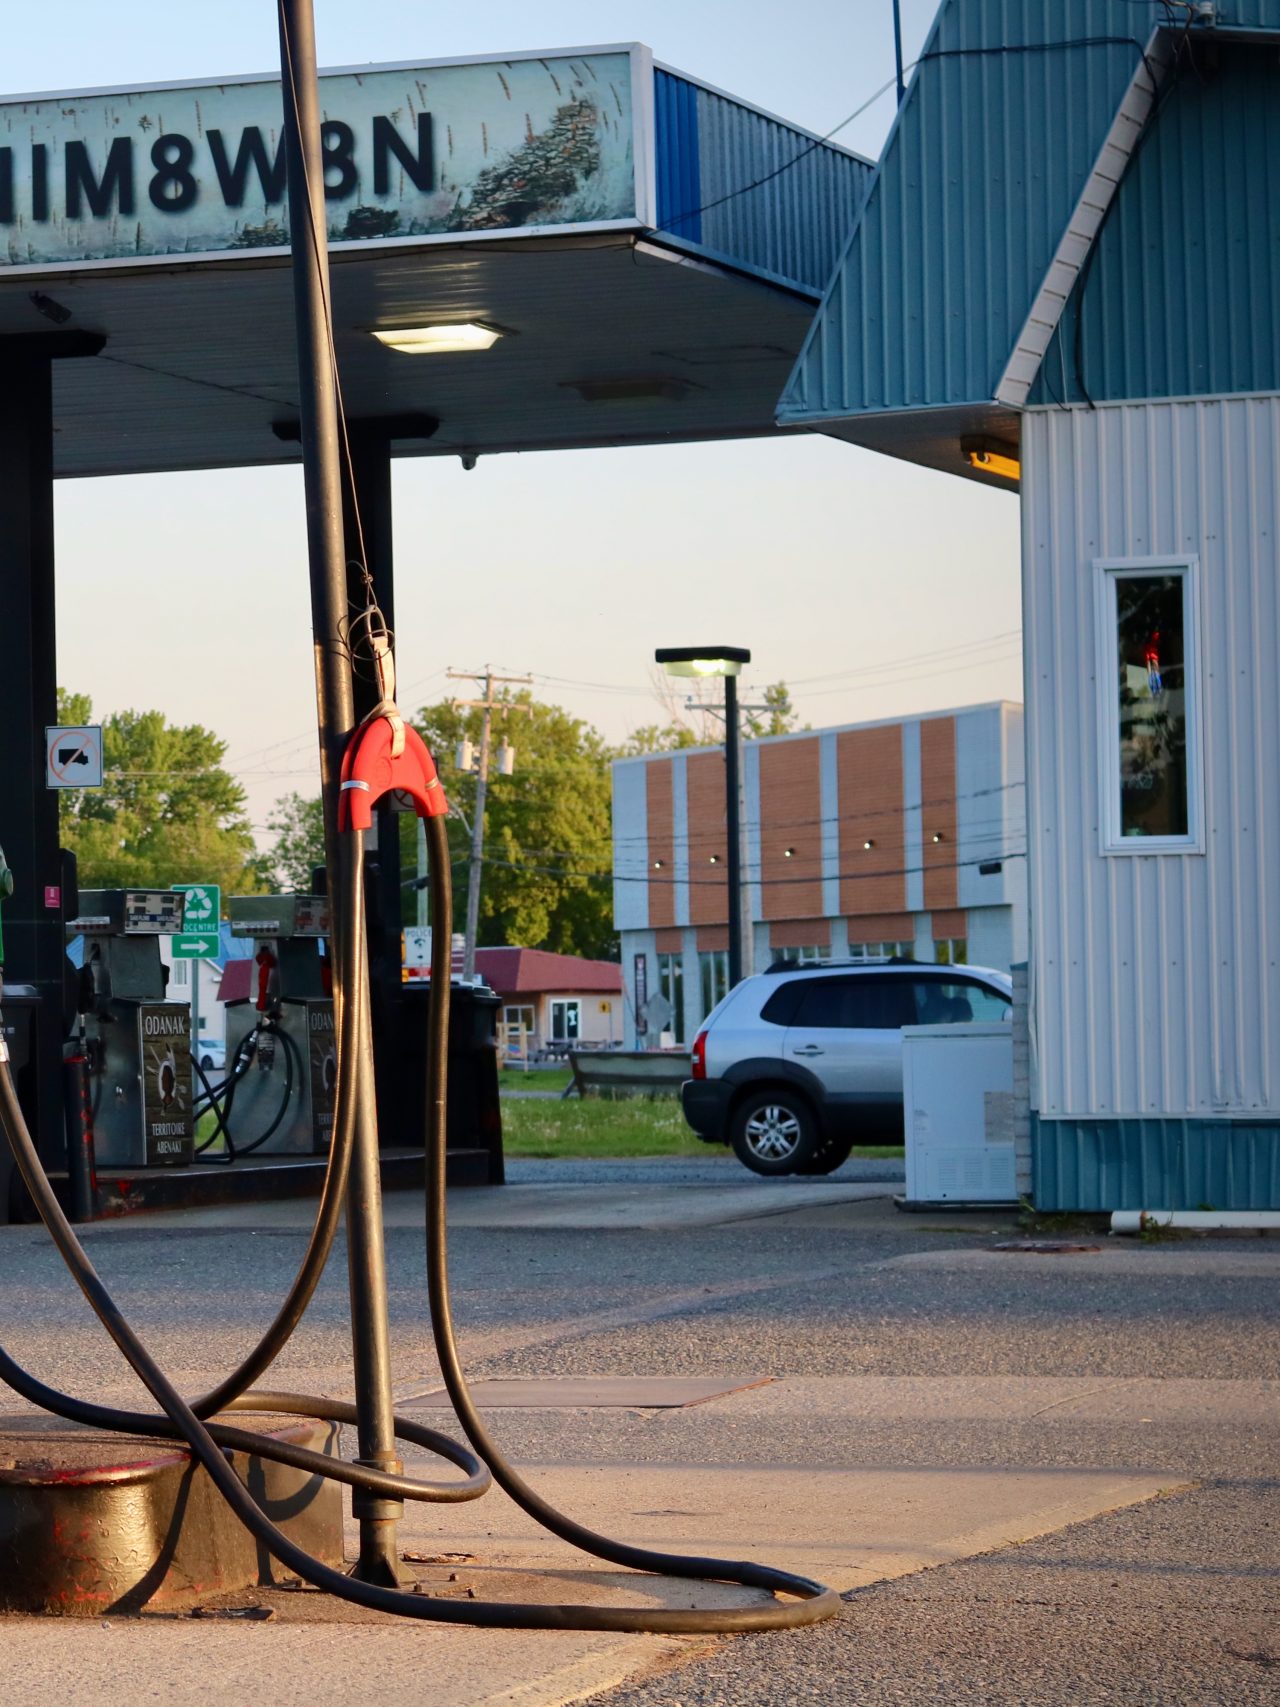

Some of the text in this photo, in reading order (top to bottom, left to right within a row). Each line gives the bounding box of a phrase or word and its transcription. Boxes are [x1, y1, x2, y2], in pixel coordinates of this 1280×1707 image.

[183, 923, 217, 932] OCENTRE
[145, 1015, 185, 1036] ODANAK
[311, 1012, 334, 1029] ODAN
[151, 1122, 185, 1136] TERRITOIRE
[157, 1141, 182, 1154] ABENAKI
